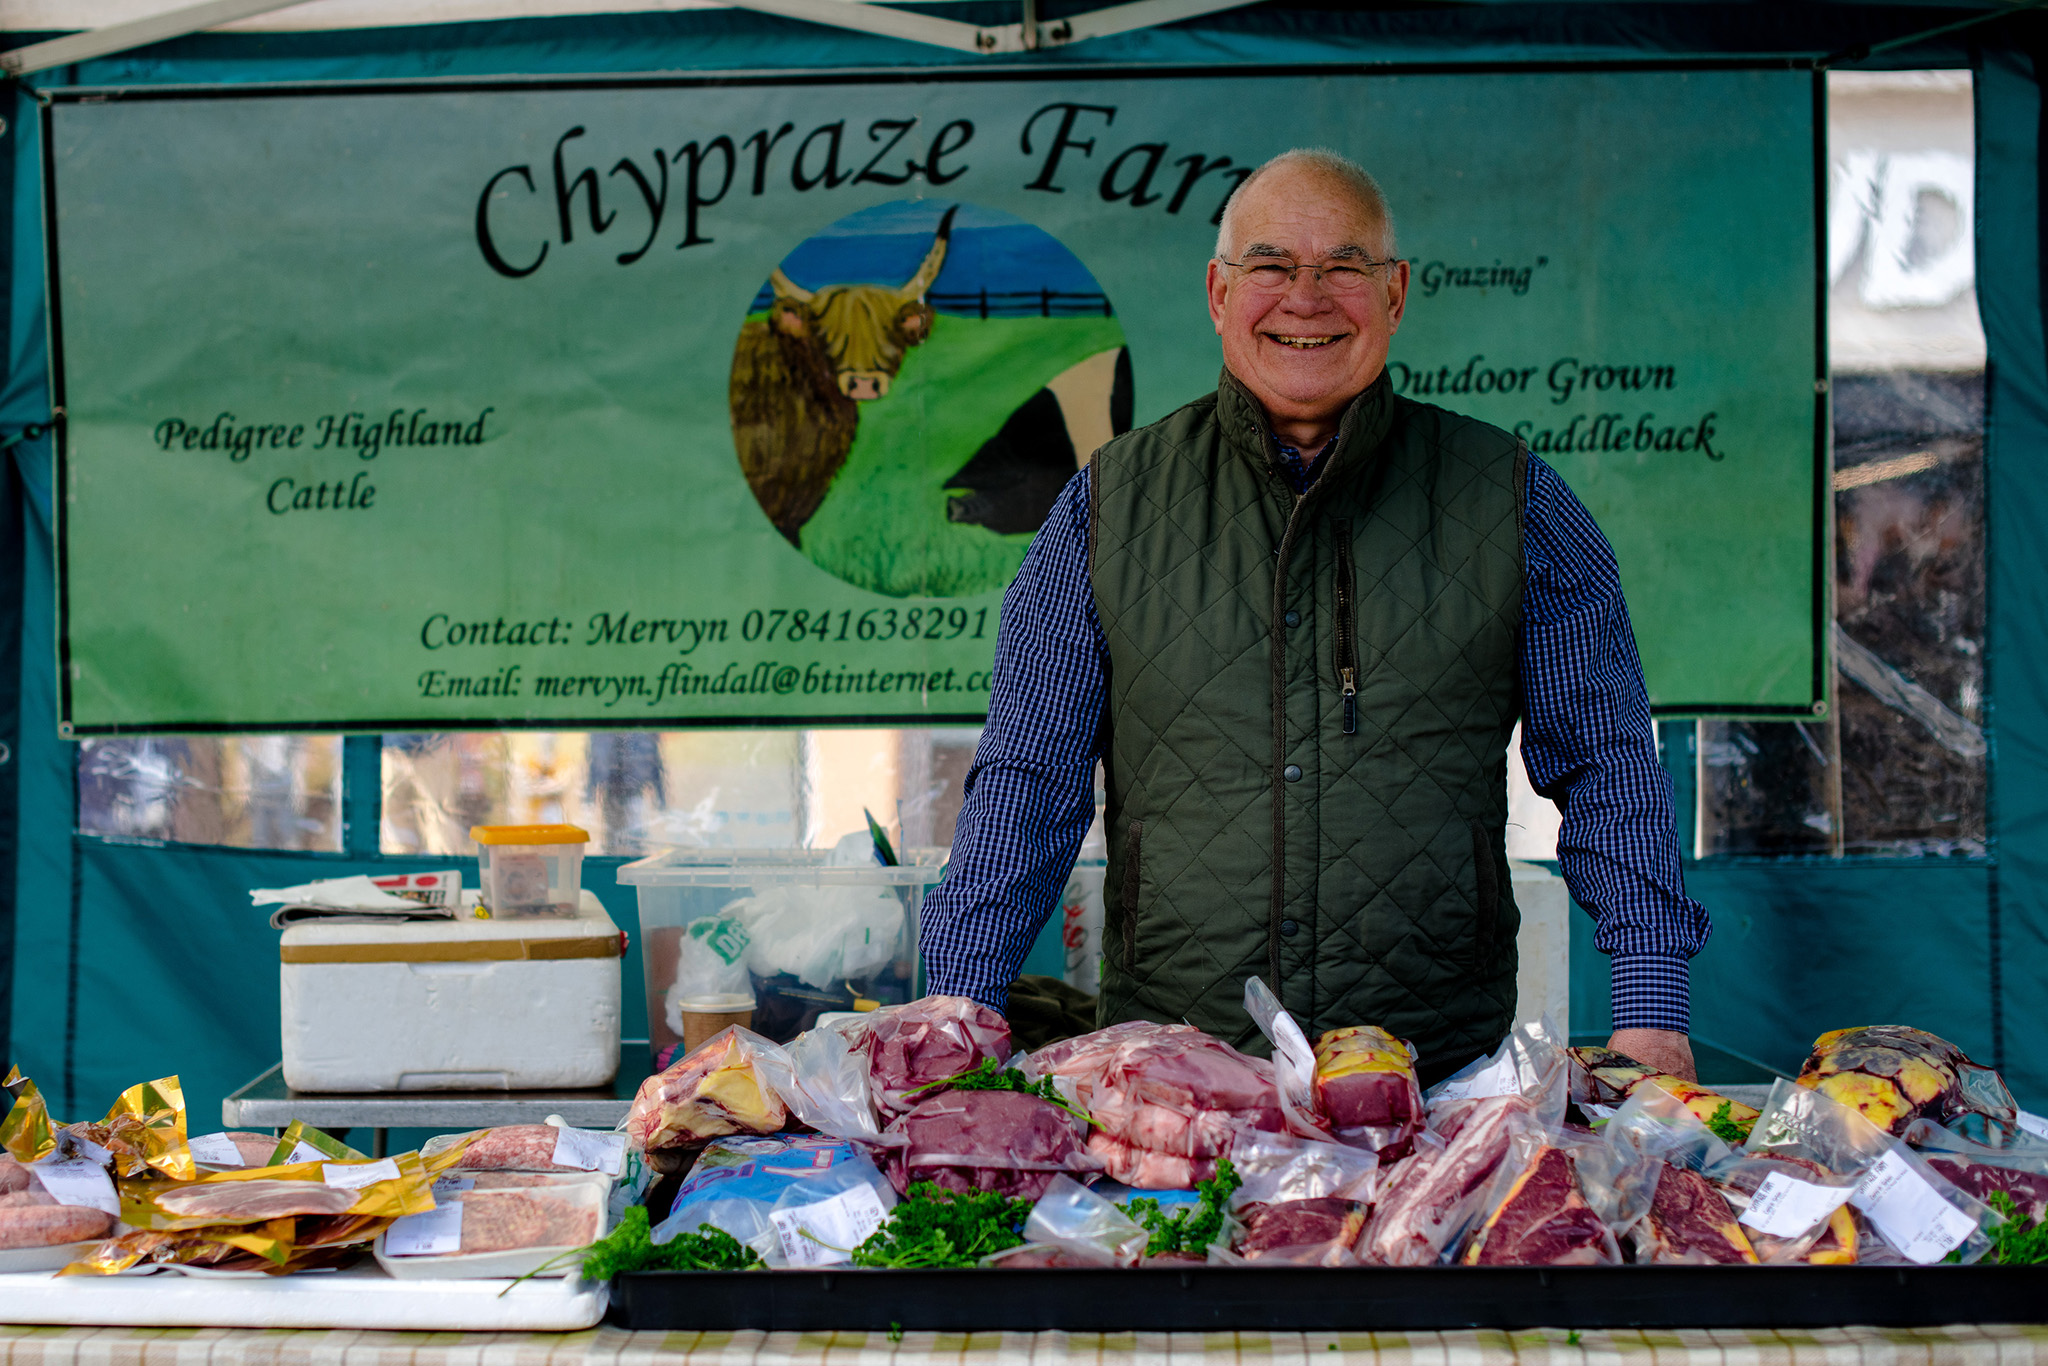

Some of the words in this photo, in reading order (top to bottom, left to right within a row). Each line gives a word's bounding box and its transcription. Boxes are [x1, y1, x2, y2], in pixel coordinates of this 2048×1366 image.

[474, 116, 976, 278] Chypraze
[1388, 354, 1538, 394] Outdoor
[1546, 357, 1677, 405] Grown
[154, 411, 305, 463] Pedigree
[313, 406, 495, 461] Highland
[1512, 411, 1725, 462] Saddleback
[266, 471, 377, 515] Cattle
[420, 614, 573, 650] Contact:
[586, 612, 728, 655] Mervyn
[742, 607, 988, 642] 07841638291
[418, 664, 522, 698] Email:
